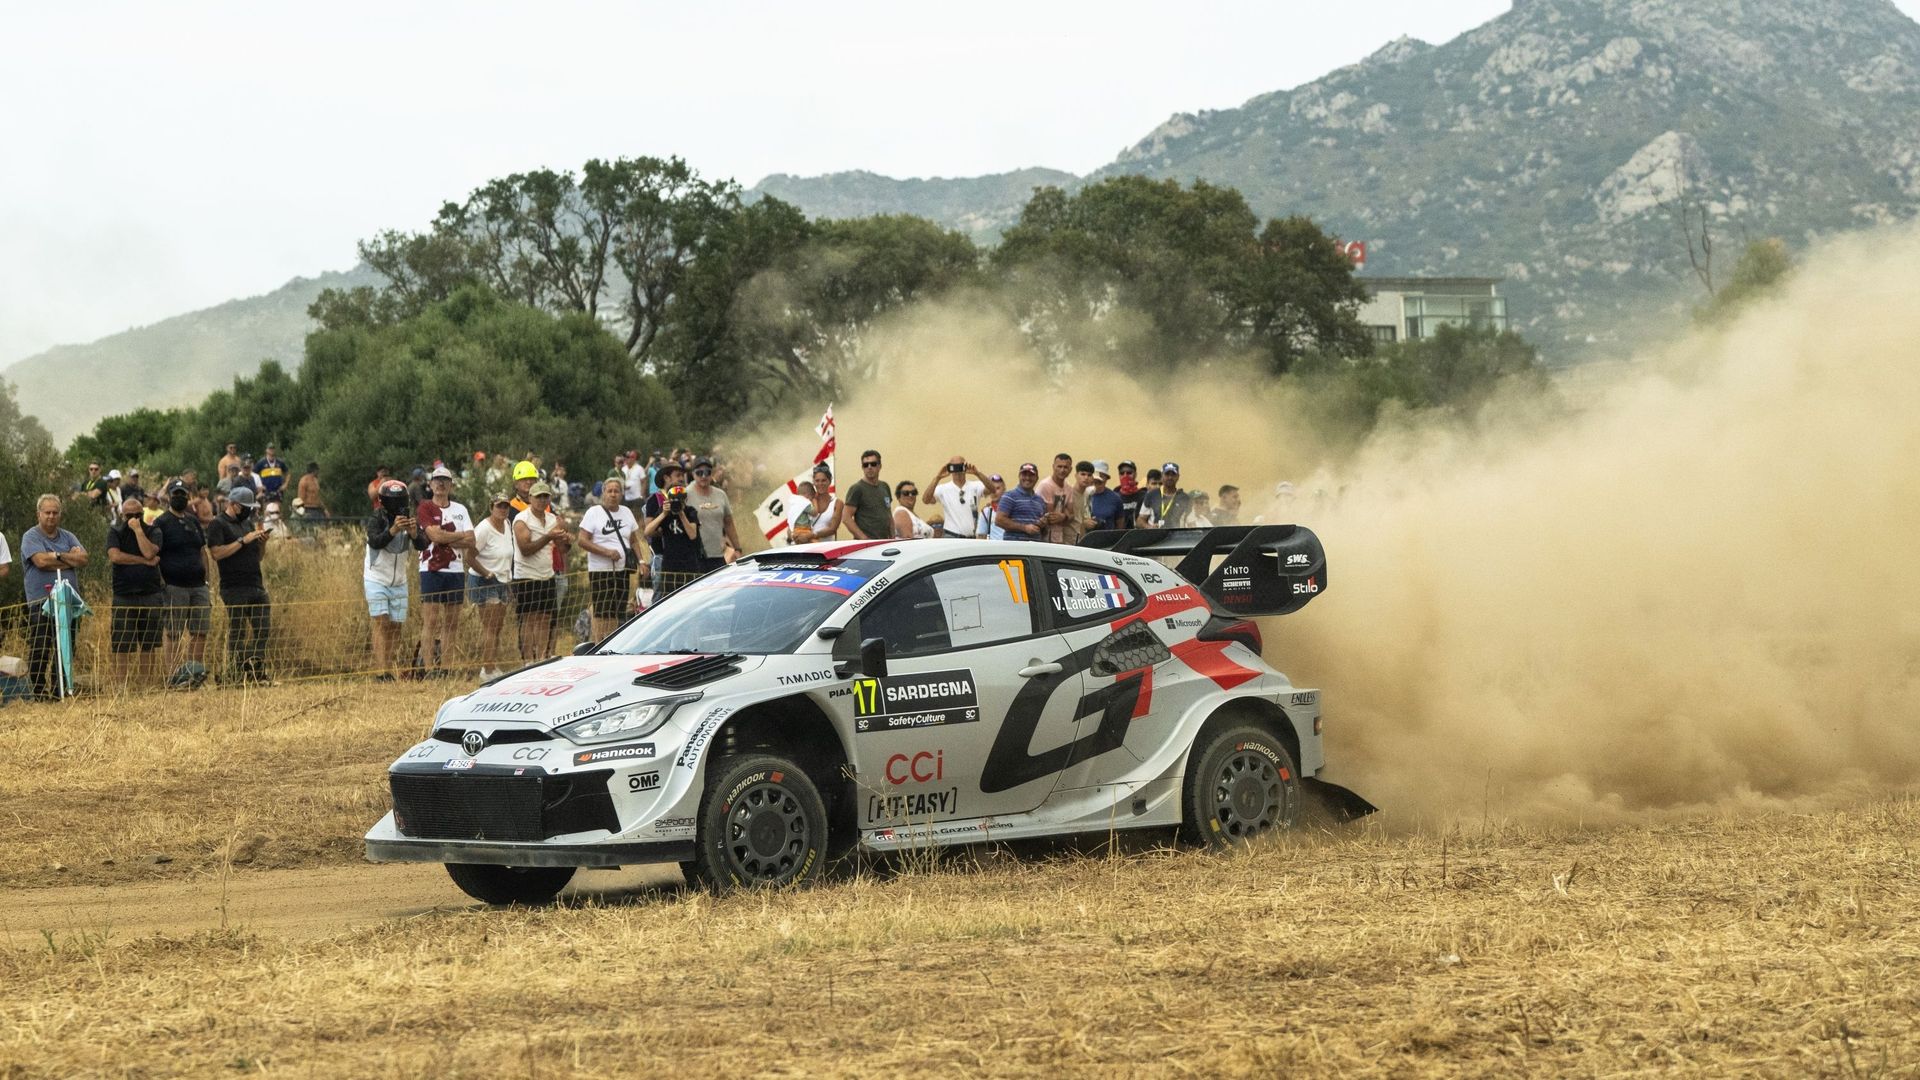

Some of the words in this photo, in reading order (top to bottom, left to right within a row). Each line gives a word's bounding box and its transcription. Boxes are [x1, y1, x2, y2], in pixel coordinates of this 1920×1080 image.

[998, 559, 1029, 604] 17
[1059, 576, 1100, 593] S.Ogier
[1052, 595, 1107, 611] V.Landais
[1155, 593, 1191, 602] NISULA
[1175, 619, 1203, 628] Microsoft
[777, 670, 832, 686] TAMADIC
[829, 687, 852, 699] PIAA
[854, 679, 877, 715] 17
[886, 680, 972, 702] SARDEGNA
[470, 702, 539, 714] TAMADIC
[888, 713, 946, 726] SafetyCulture
[676, 707, 724, 768] Panasonic
[687, 706, 734, 770] AUTOMOTIVE
[628, 773, 661, 790] OMP
